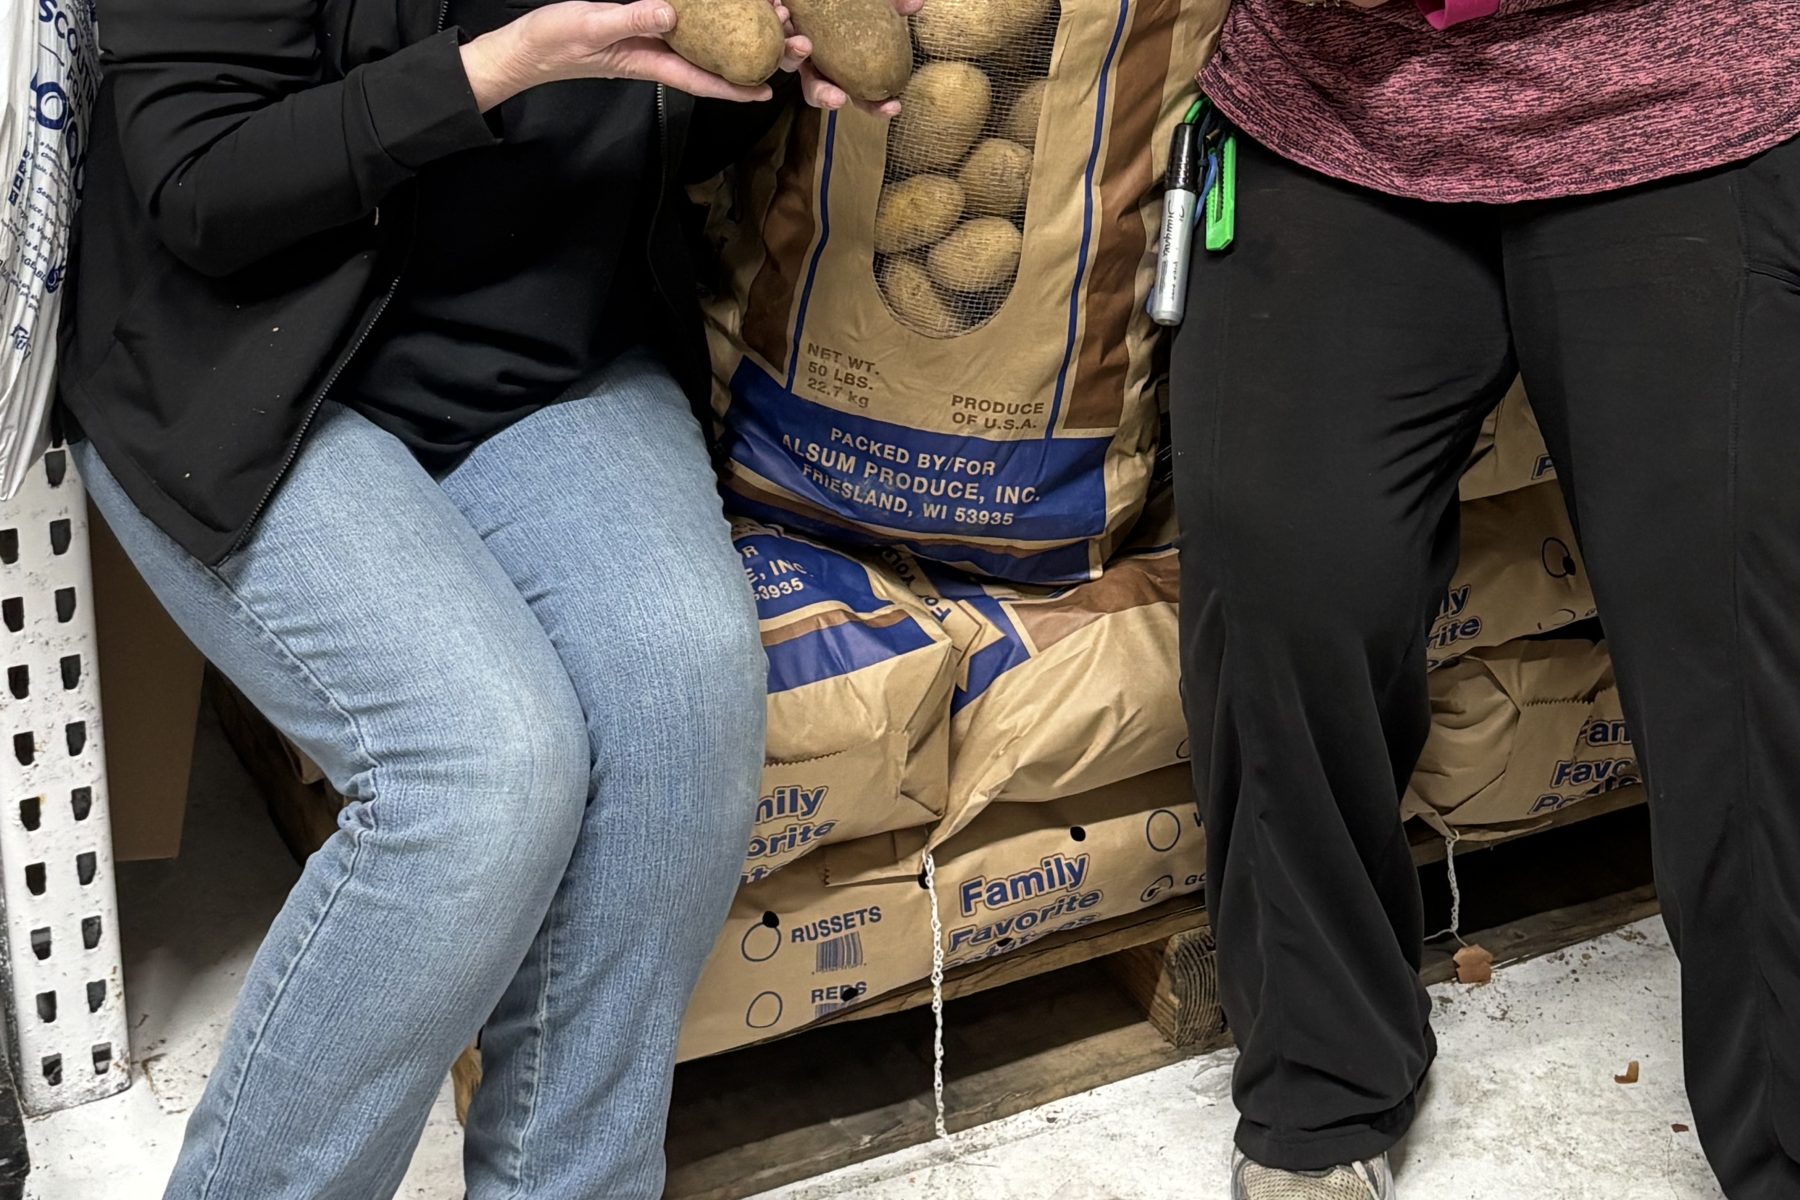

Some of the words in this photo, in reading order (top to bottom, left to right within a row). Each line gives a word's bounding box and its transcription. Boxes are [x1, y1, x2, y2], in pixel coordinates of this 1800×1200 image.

[807, 342, 843, 363] NET
[848, 354, 880, 376] WT.
[808, 361, 829, 377] 50
[833, 369, 874, 391] LBS.
[807, 377, 842, 397] 22.7
[848, 388, 870, 408] kg
[951, 394, 1045, 416] PRODUCE
[952, 411, 978, 426] OF
[984, 417, 1037, 431] U.S.A.
[782, 434, 857, 474] ALSUM
[864, 461, 985, 504] PRODUCE,
[995, 485, 1041, 505] INC.
[831, 427, 910, 465] PACKED
[917, 453, 996, 477] BY/FOR
[803, 463, 914, 518] FRIESLAND,
[922, 502, 948, 520] WI
[954, 507, 1014, 526] 53935
[961, 855, 1088, 915] Family
[791, 906, 882, 943] RUSSETS
[949, 891, 1101, 954] Favorite
